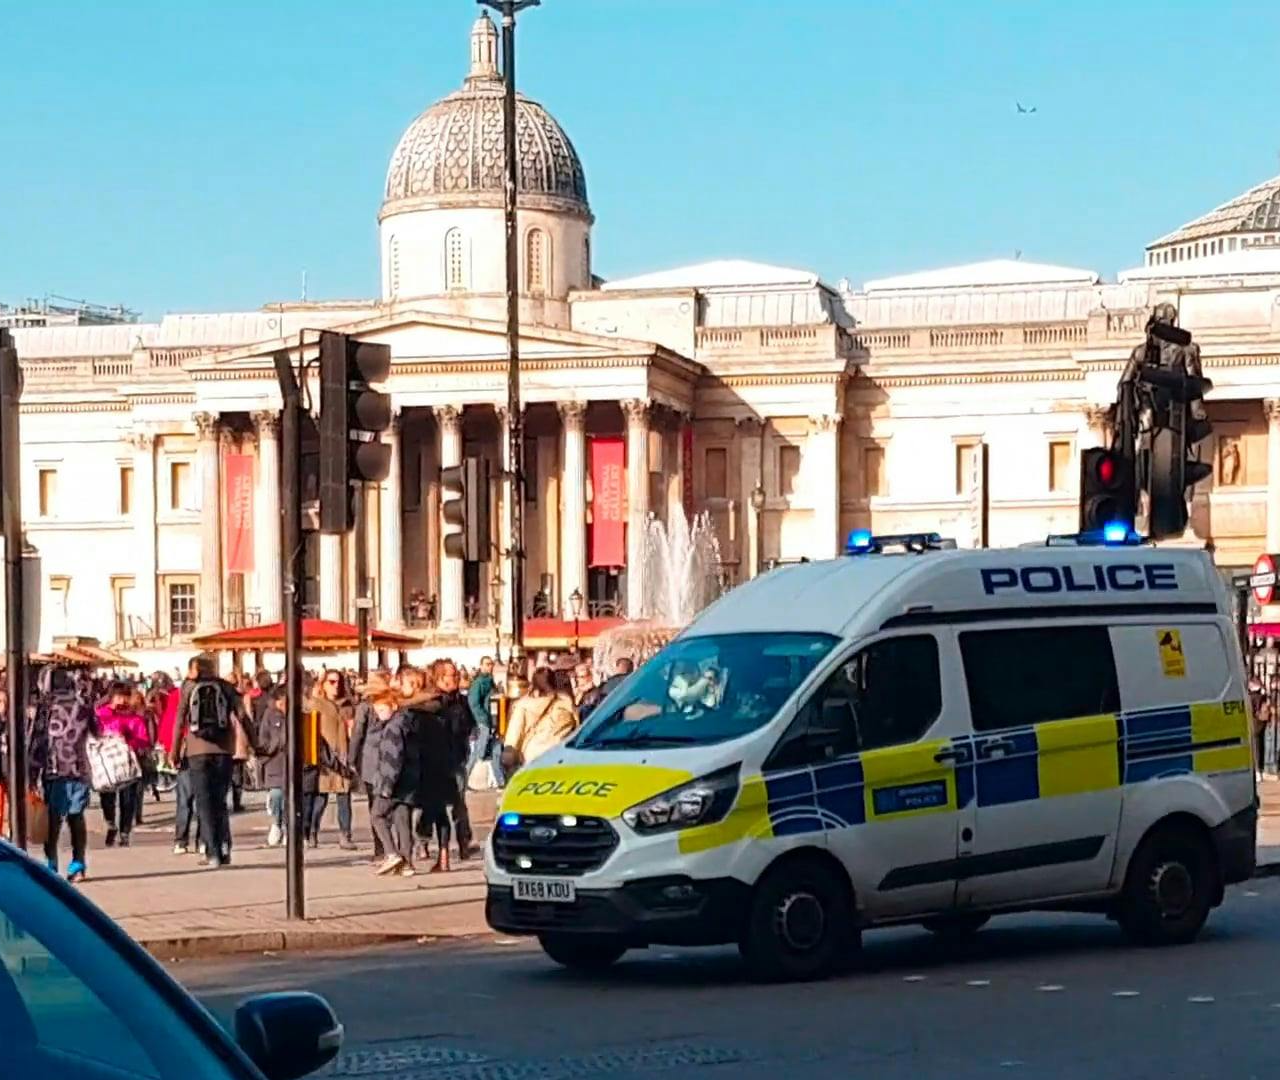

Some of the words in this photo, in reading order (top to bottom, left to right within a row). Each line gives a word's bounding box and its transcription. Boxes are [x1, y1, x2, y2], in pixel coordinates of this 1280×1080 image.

[980, 563, 1179, 595] POLICE
[517, 781, 618, 797] POLICE
[517, 880, 544, 897] BX68
[546, 880, 571, 898] KDU
